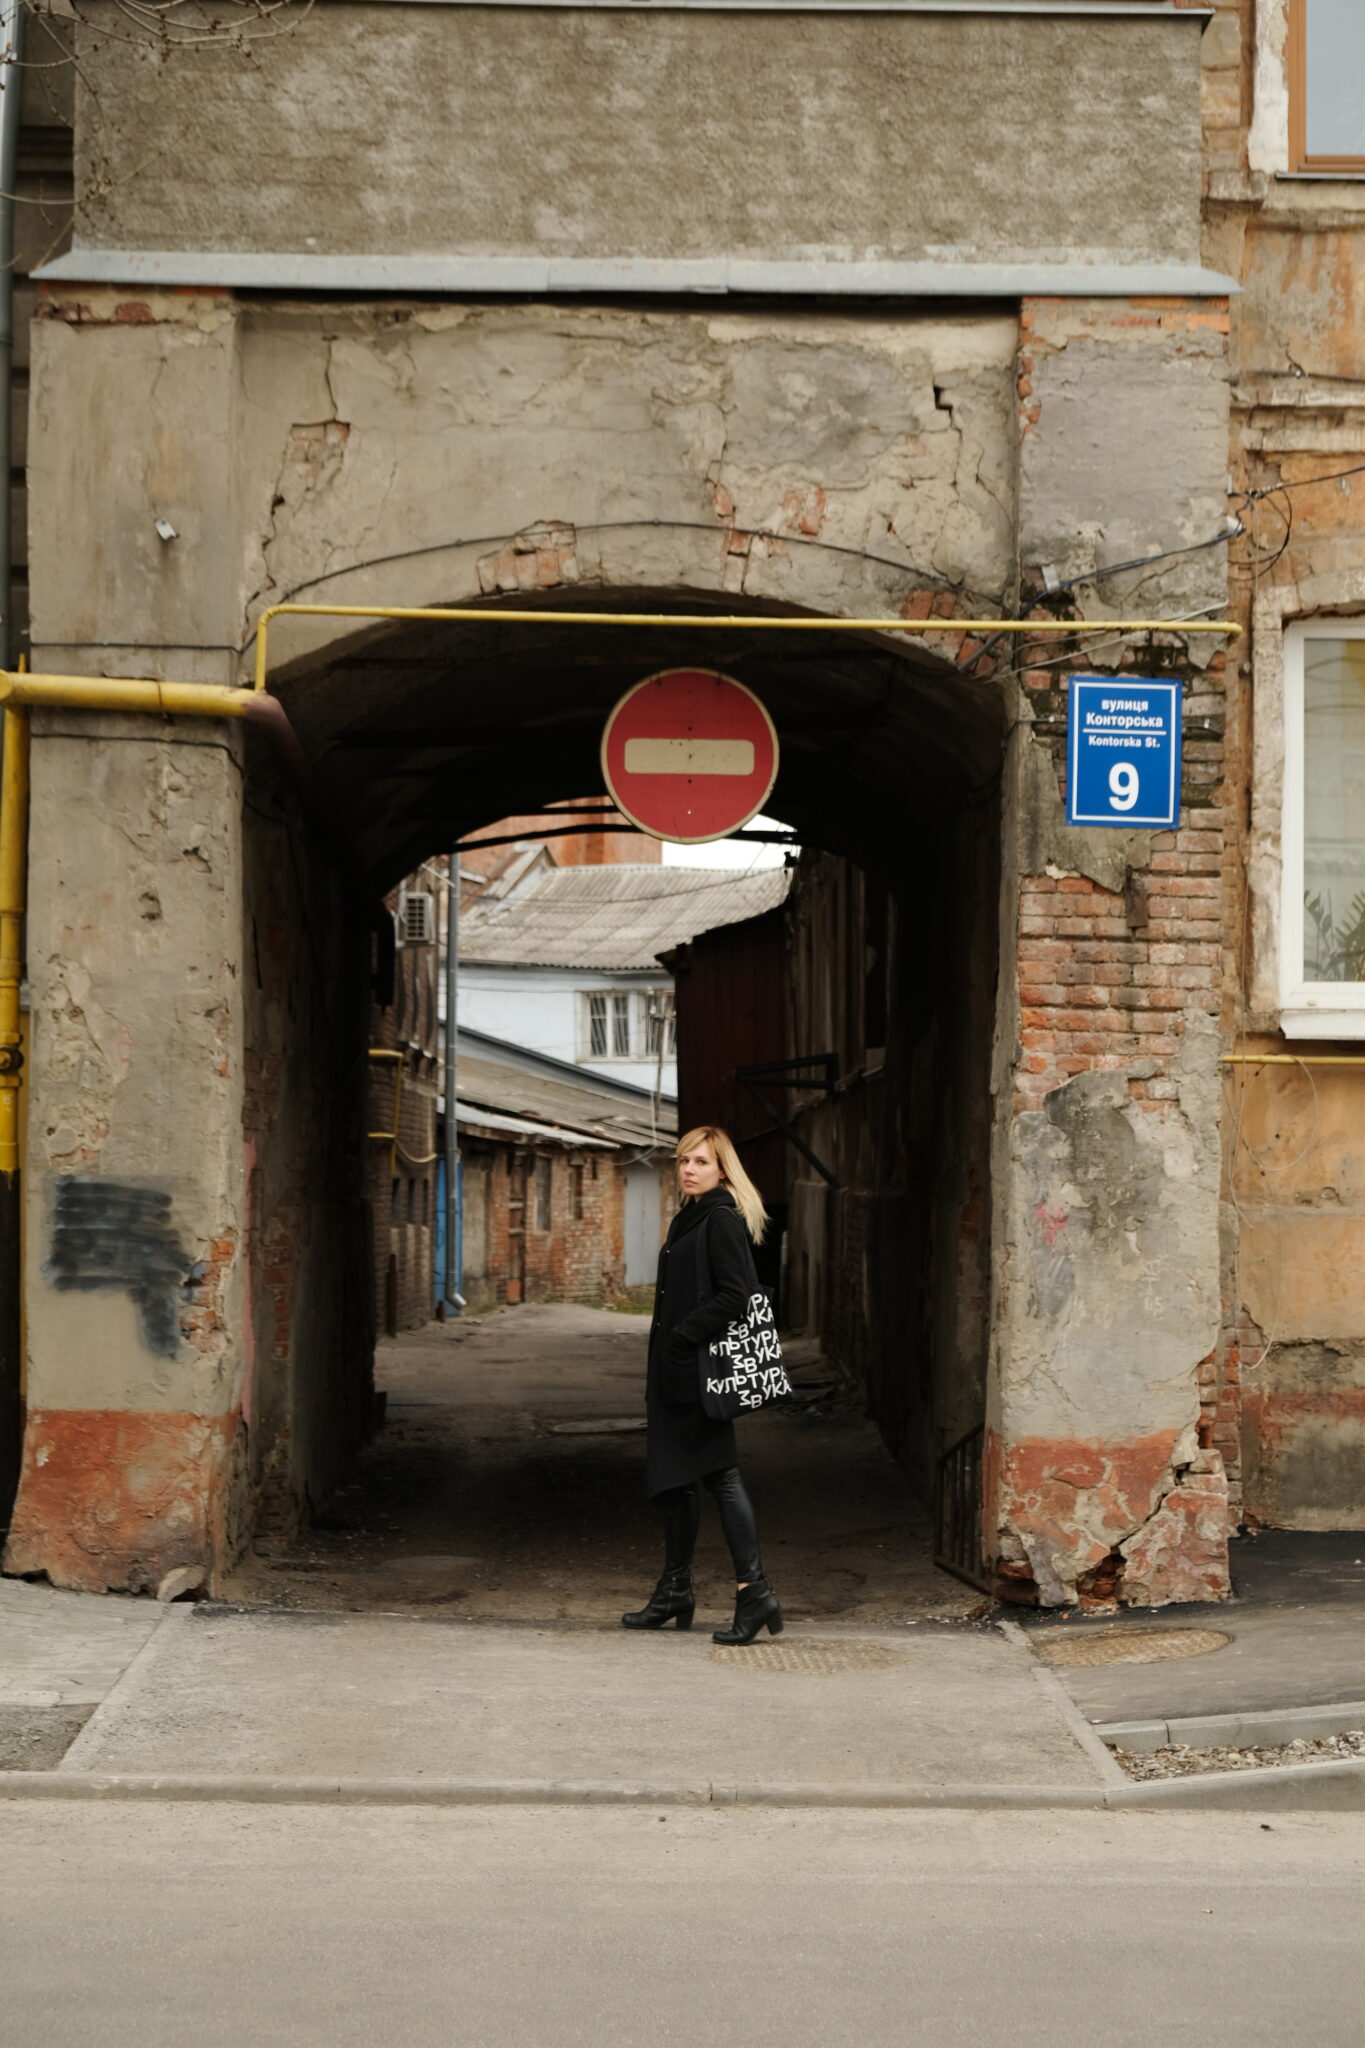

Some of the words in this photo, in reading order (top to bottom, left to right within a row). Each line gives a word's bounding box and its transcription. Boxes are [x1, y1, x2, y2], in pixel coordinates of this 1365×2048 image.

[1101, 699, 1149, 713] вулиця
[1086, 712, 1163, 729] Конторська
[1088, 735, 1142, 748] Kontorska
[1145, 737, 1160, 748] St.
[1108, 762, 1139, 811] 9
